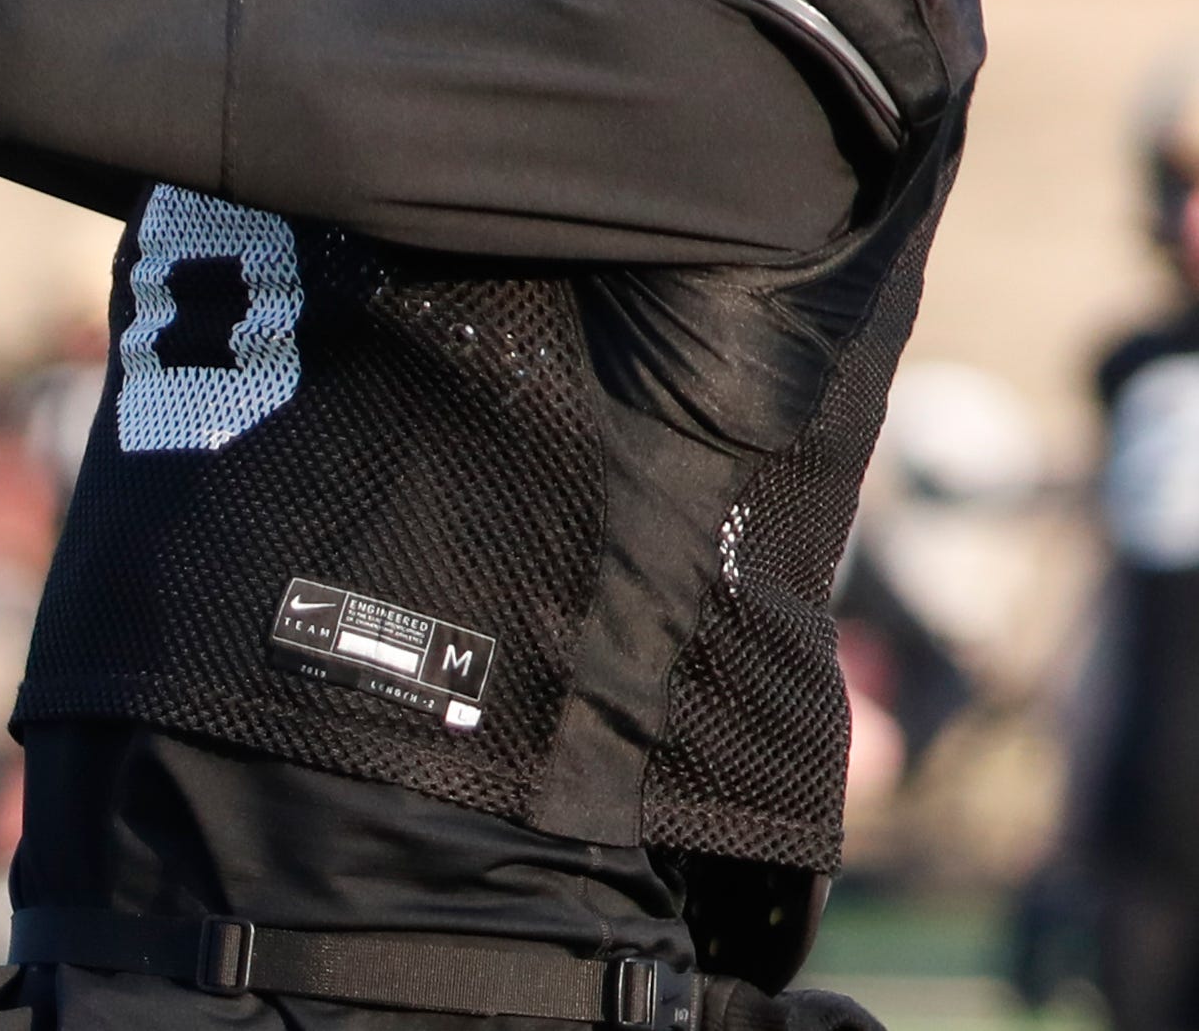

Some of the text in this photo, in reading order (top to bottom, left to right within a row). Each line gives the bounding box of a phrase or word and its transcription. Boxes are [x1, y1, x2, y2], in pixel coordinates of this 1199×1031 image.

[284, 616, 330, 638] TEAM
[348, 599, 429, 632] ENGINEERED
[442, 644, 473, 677] M
